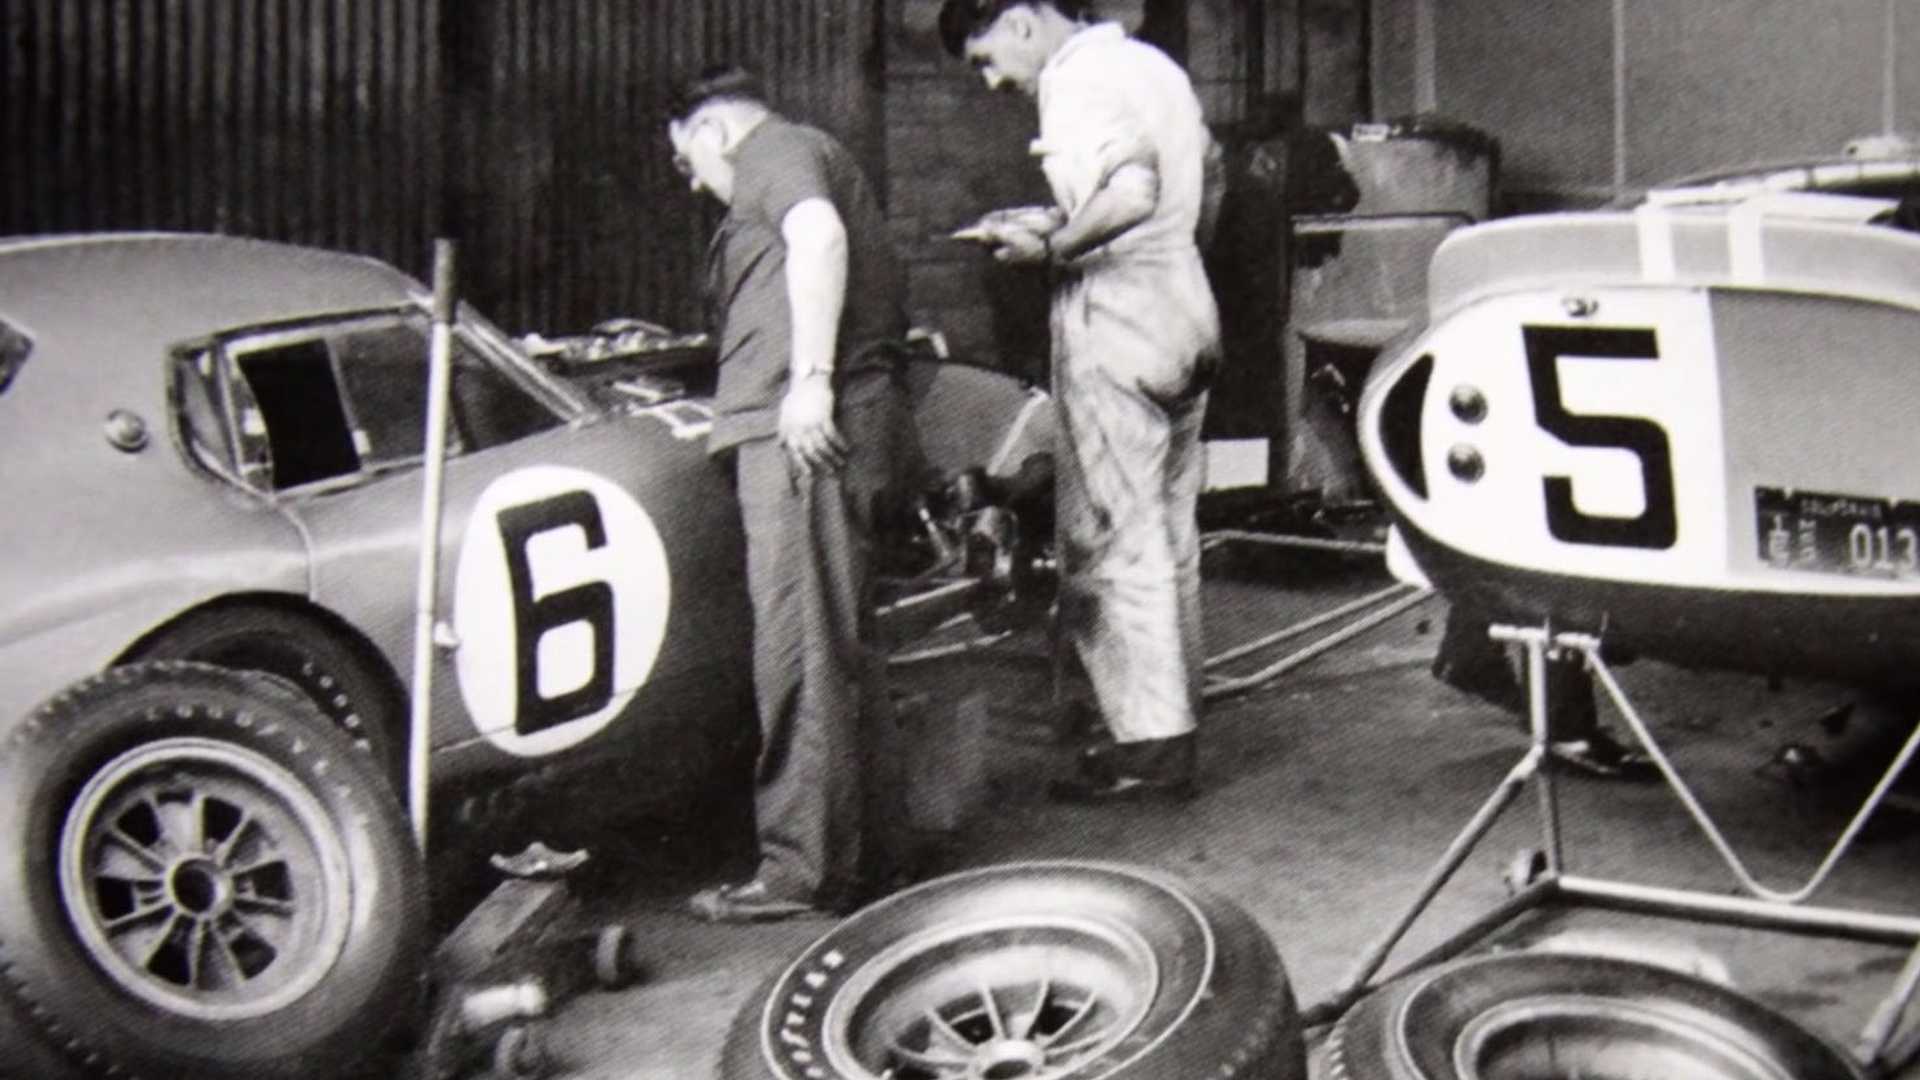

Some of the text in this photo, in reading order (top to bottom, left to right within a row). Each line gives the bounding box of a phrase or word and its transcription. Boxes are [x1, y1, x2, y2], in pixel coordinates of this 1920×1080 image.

[1521, 325, 1677, 550] 5
[1851, 523, 1917, 571] 013
[497, 489, 614, 736] 6
